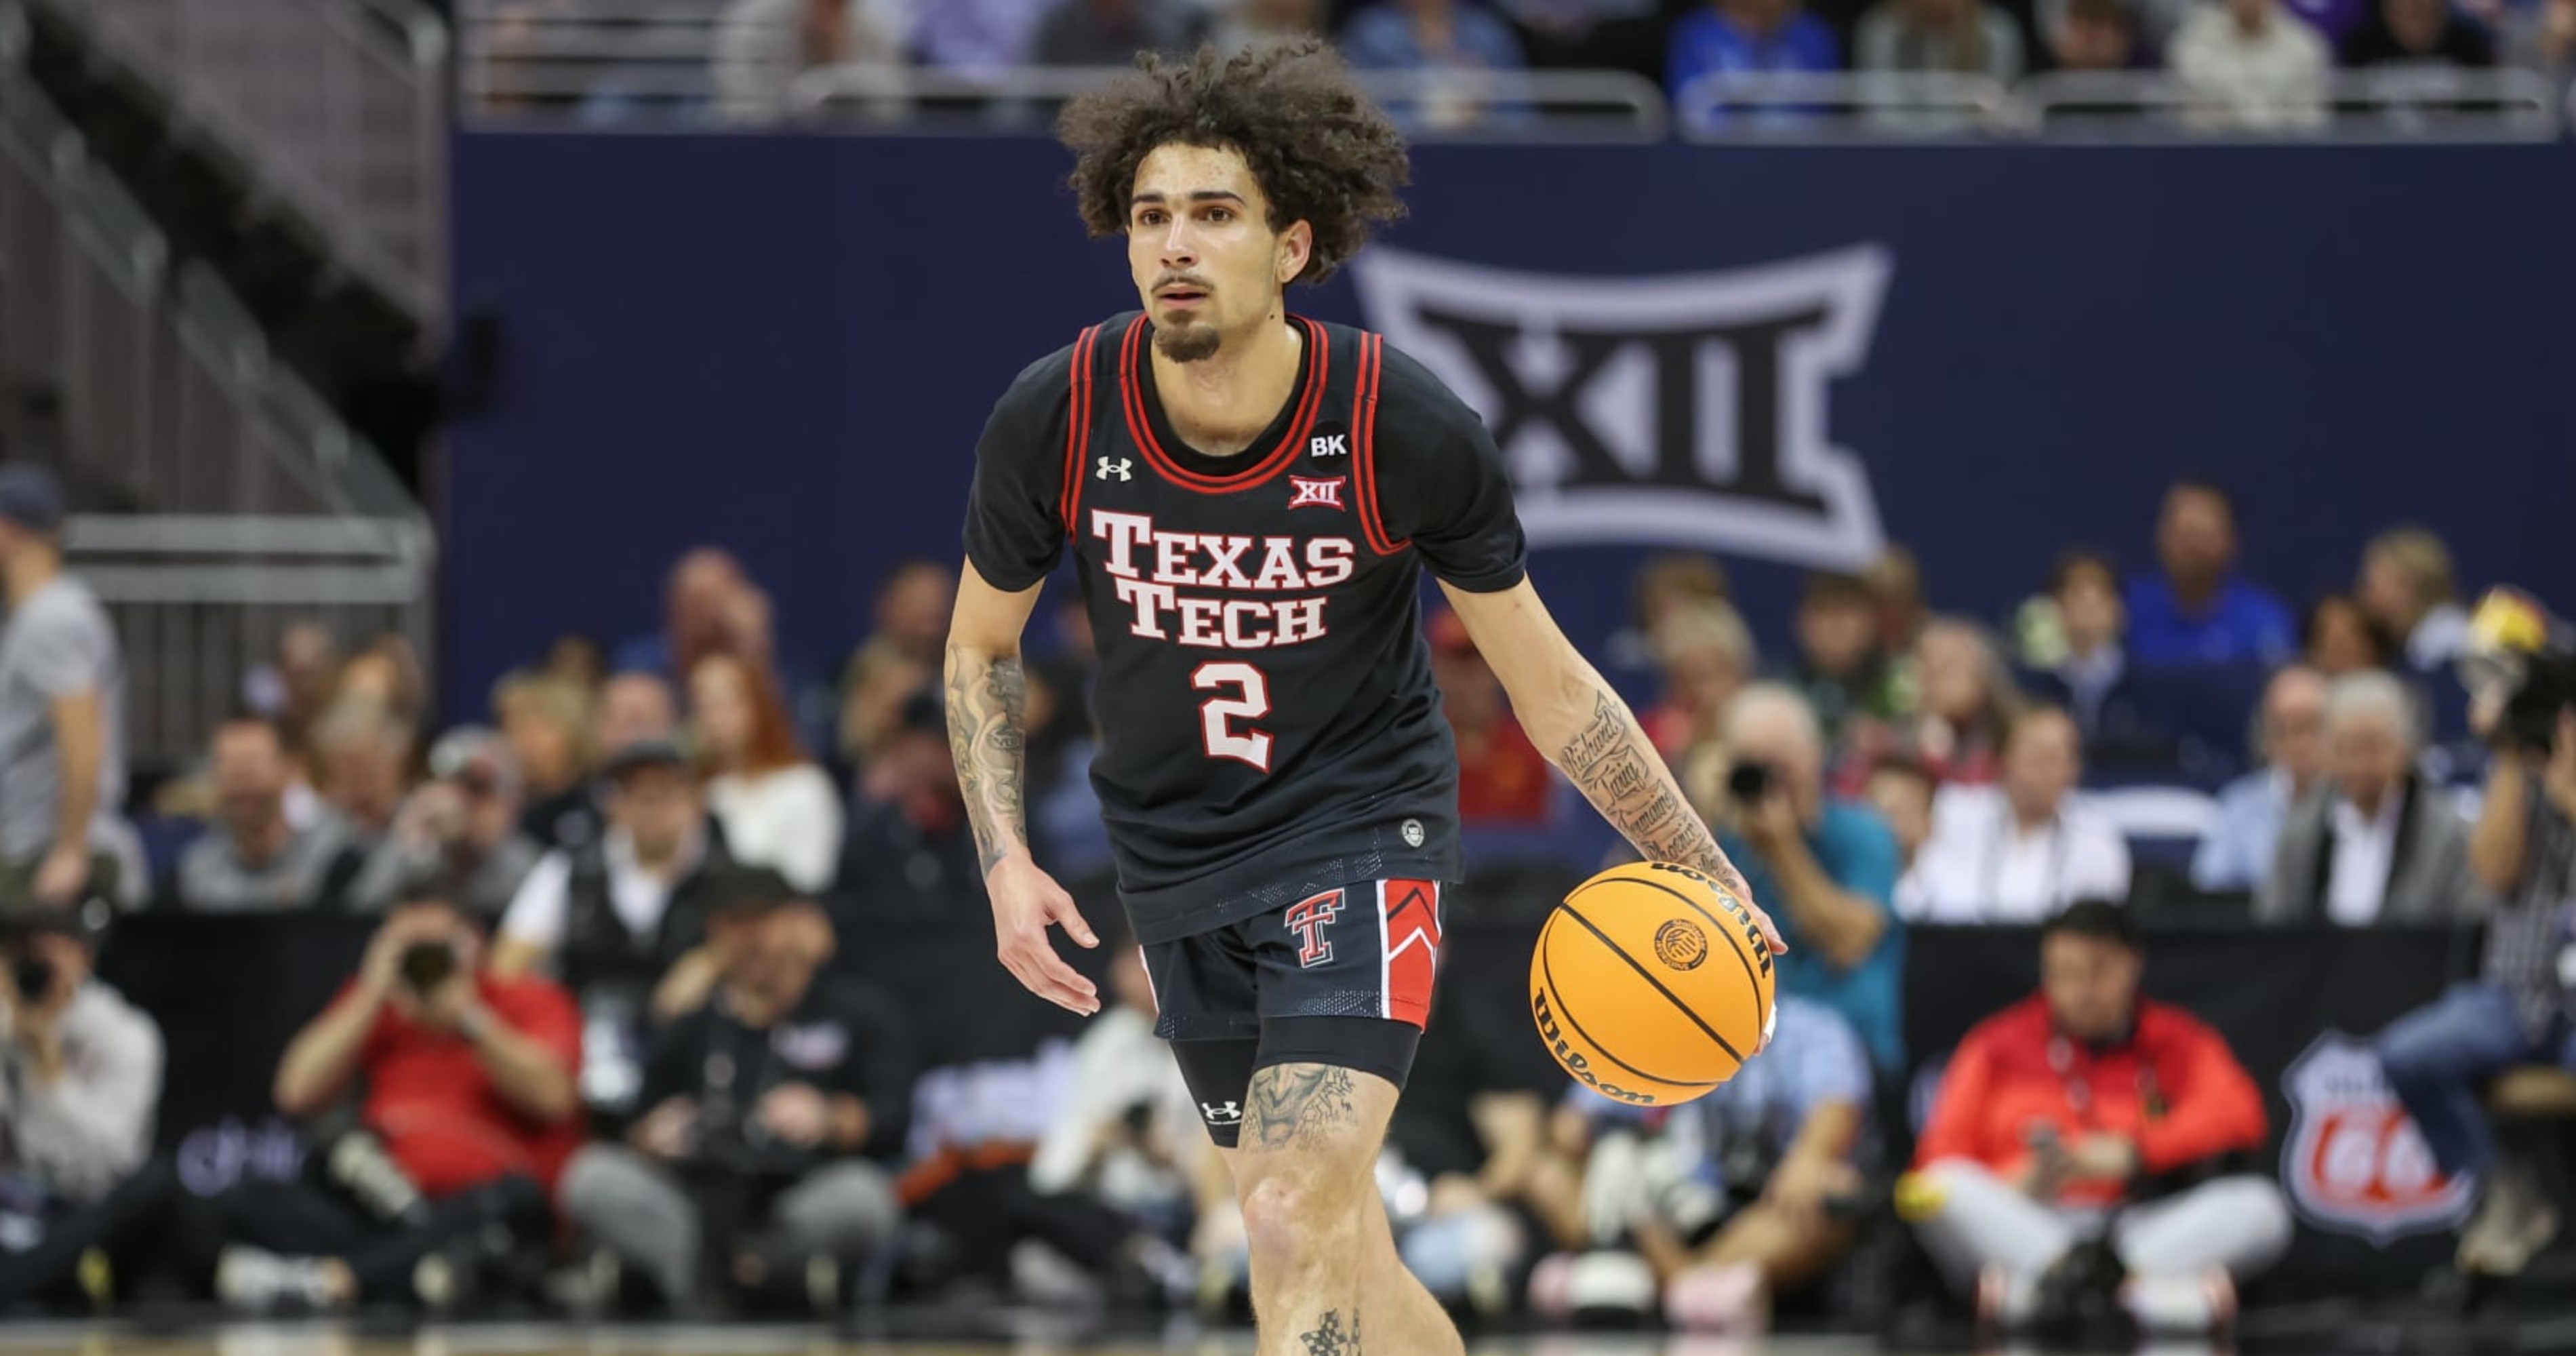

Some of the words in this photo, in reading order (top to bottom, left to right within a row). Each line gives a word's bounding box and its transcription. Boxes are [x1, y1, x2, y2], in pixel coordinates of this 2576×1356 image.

[1310, 434, 1348, 458] BK
[1407, 298, 1836, 521] XII
[1290, 477, 1344, 507] XII
[1091, 509, 1354, 590] TEXAS
[1114, 576, 1328, 649] TECH
[1190, 660, 1274, 774] 2
[1533, 986, 1656, 1104] Wilson
